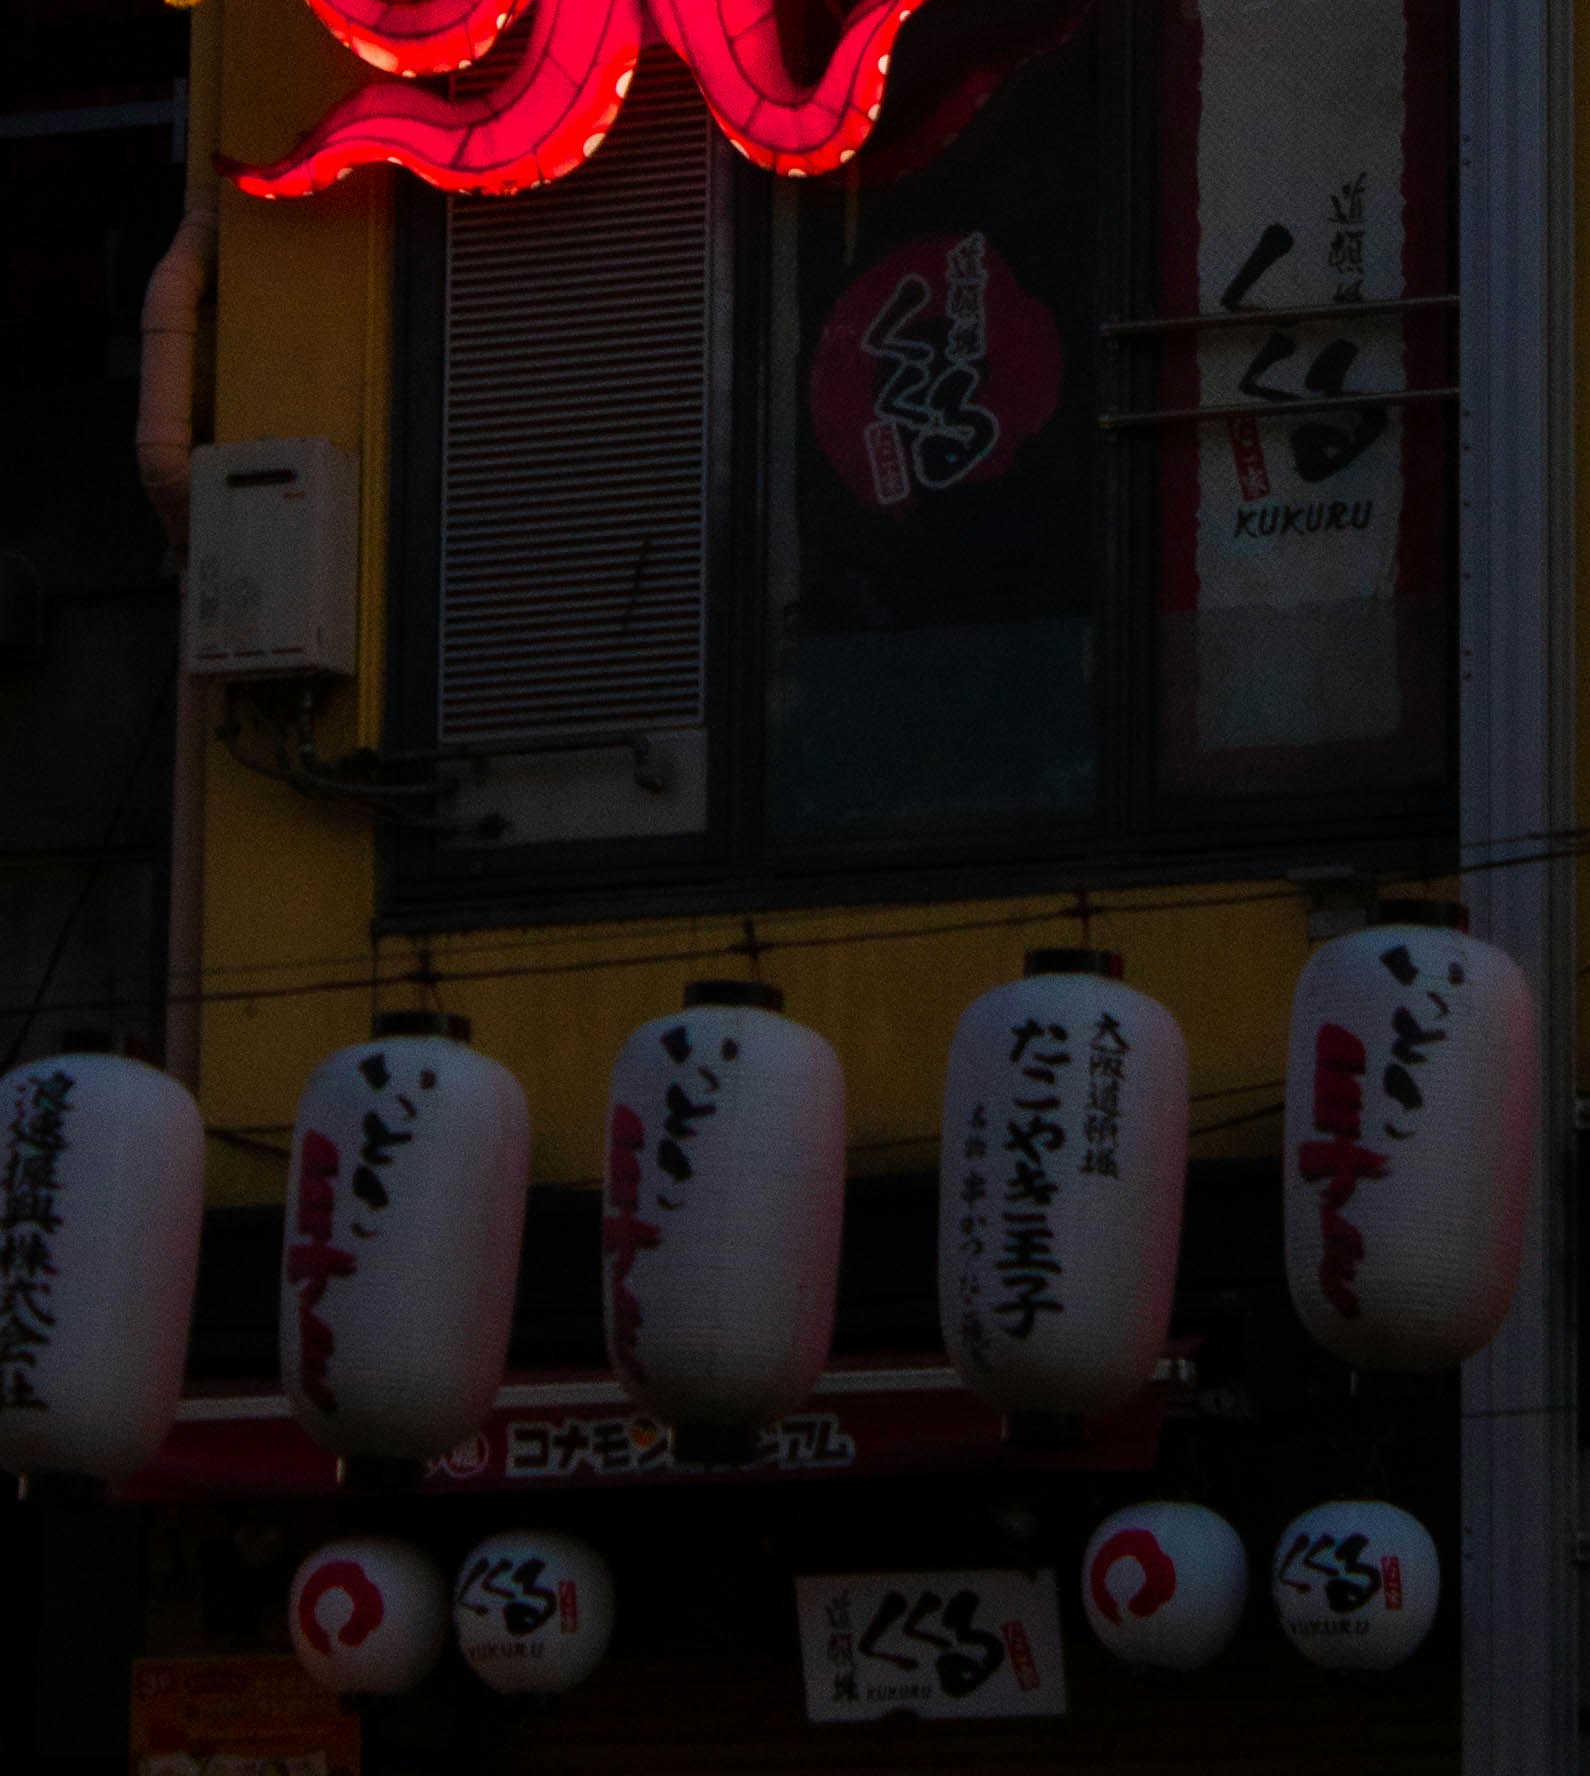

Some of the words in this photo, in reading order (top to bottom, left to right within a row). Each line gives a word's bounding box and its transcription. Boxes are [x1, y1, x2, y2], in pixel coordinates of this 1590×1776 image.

[861, 272, 999, 489] くくる
[1221, 224, 1388, 483] くくる
[1235, 501, 1373, 539] KUKURU
[993, 1019, 1072, 1339] たこやき王子
[506, 1414, 857, 1477] コナモンアム
[457, 1558, 557, 1635] くくる
[1279, 1534, 1380, 1613] くくる
[860, 1590, 1004, 1697] くくる
